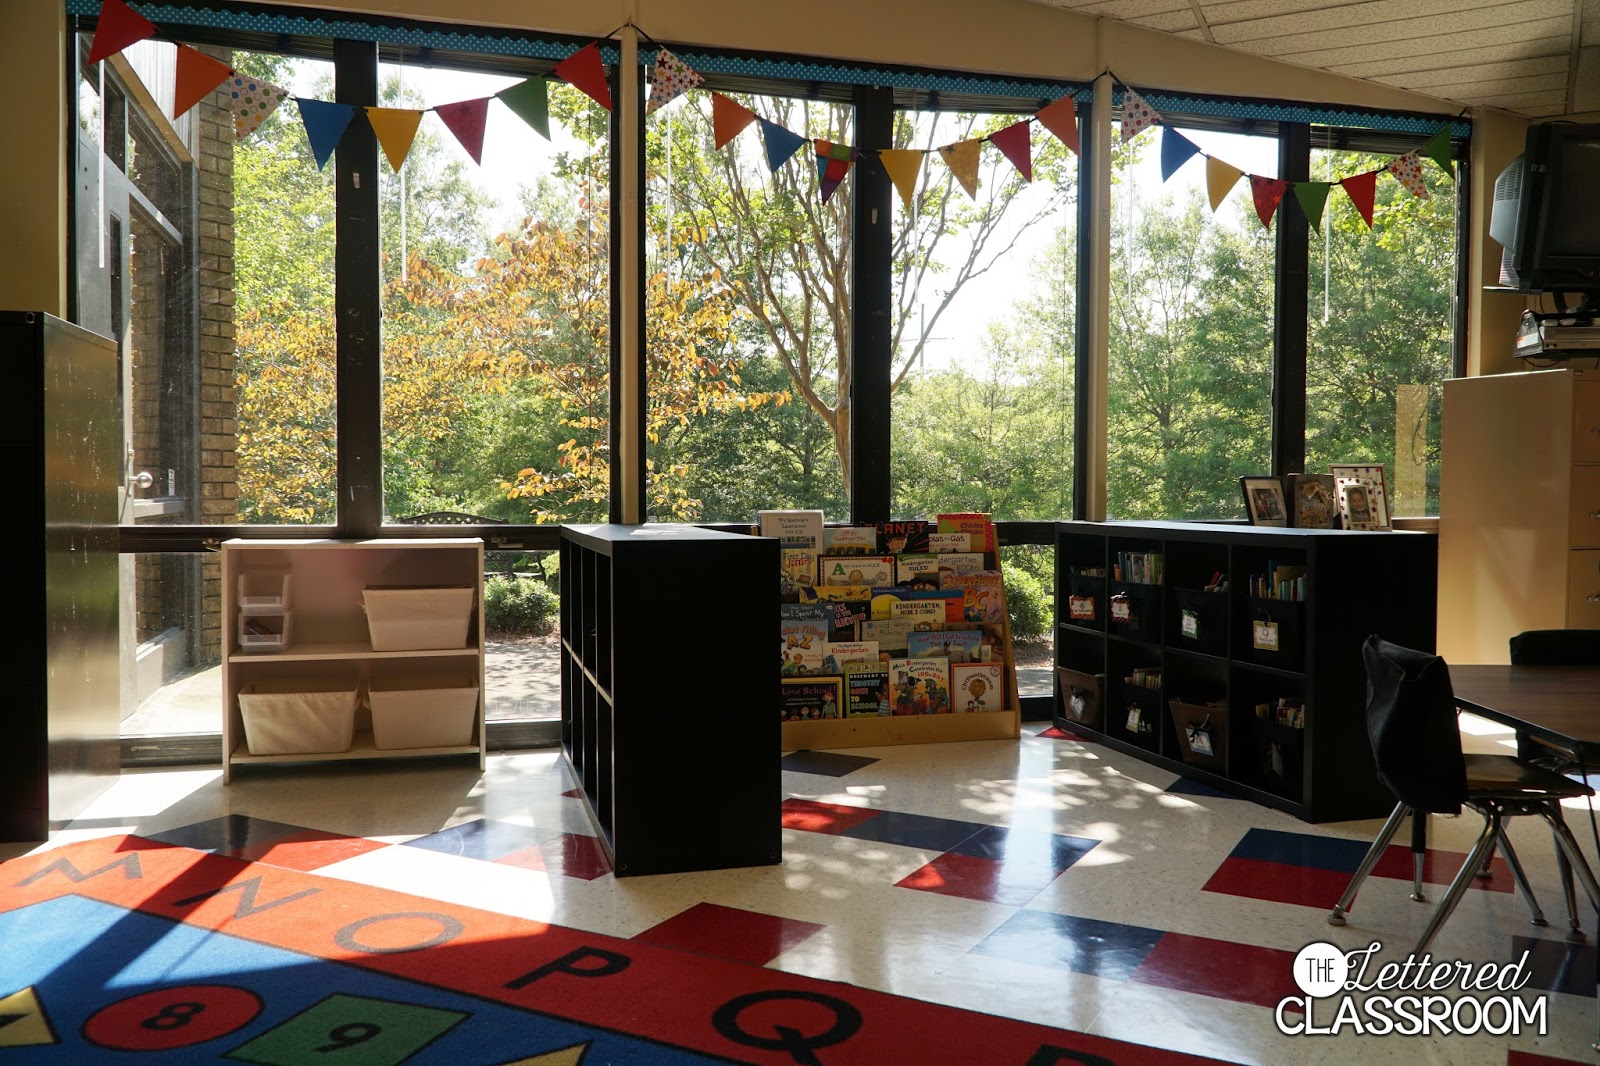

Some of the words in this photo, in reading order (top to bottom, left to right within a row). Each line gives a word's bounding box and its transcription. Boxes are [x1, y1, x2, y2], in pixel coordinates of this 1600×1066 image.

[783, 552, 798, 560] First
[801, 552, 815, 561] Day
[939, 556, 977, 565] dergarten
[786, 558, 812, 568] Jitters
[832, 563, 846, 576] A
[964, 588, 990, 610] BC
[796, 610, 812, 618] Spent
[814, 610, 825, 618] My
[1262, 628, 1269, 638] 9
[787, 635, 798, 650] A
[800, 634, 814, 650] Z
[831, 648, 868, 656] Kindergarten
[782, 687, 800, 696] Love
[802, 686, 836, 695] School!
[333, 911, 465, 954] O
[505, 946, 631, 990] P
[712, 990, 862, 1066] Q
[140, 1002, 206, 1030] 8
[315, 1021, 382, 1053] 9
